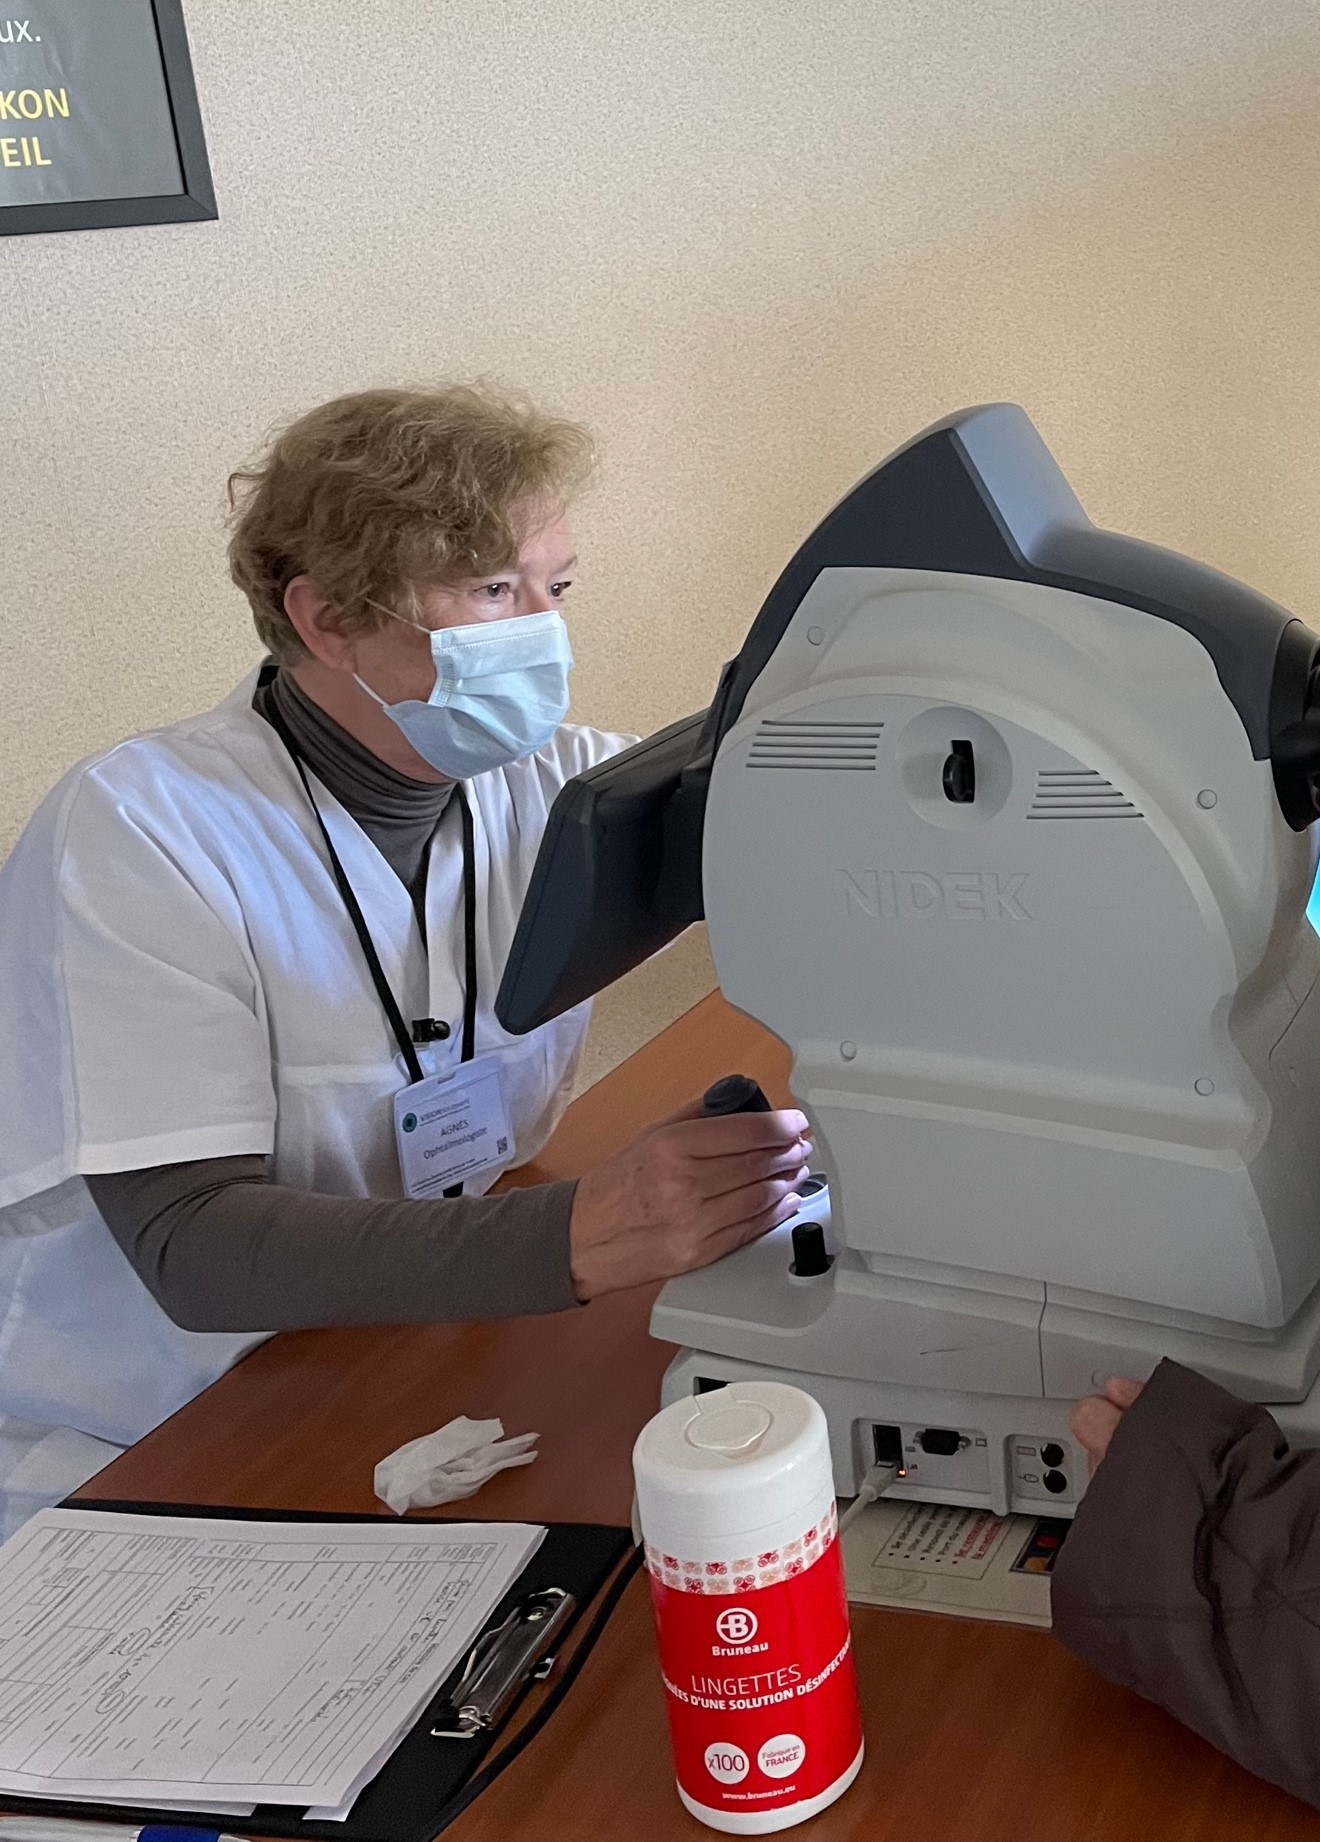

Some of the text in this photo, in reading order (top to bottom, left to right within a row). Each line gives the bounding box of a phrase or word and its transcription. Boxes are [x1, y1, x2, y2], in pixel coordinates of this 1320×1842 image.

[0, 136, 52, 167] EIL
[835, 868, 1033, 921] NIDEK
[712, 1642, 769, 1657] Bruneau
[692, 1664, 801, 1695] LINGETTES
[690, 1695, 726, 1710] D'UNE
[729, 1688, 794, 1710] SOLUTION
[708, 1754, 745, 1771] x100
[766, 1752, 799, 1768] FRANCE
[722, 1785, 796, 1800] www.bruneau.eu
